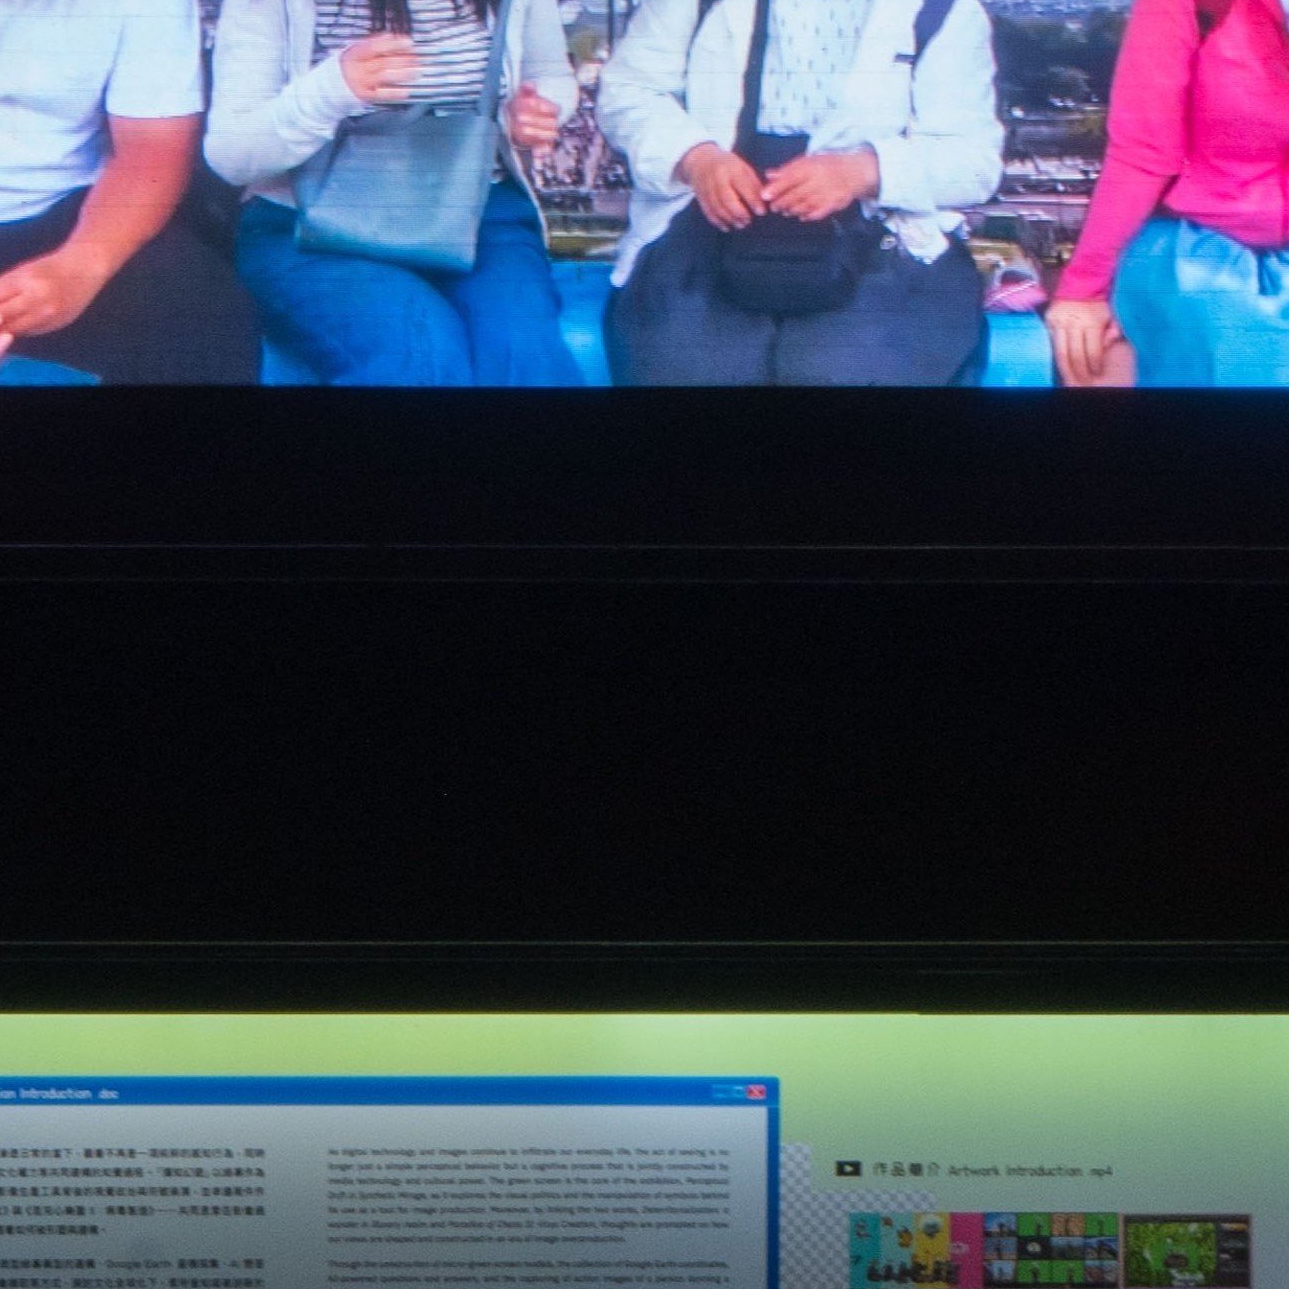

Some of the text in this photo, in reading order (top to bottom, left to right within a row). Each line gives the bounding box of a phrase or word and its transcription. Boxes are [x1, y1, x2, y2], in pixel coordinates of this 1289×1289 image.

[20, 1087, 91, 1099] Introduction
[948, 1164, 999, 1177] Artwork
[1006, 1164, 1082, 1177] Introduction
